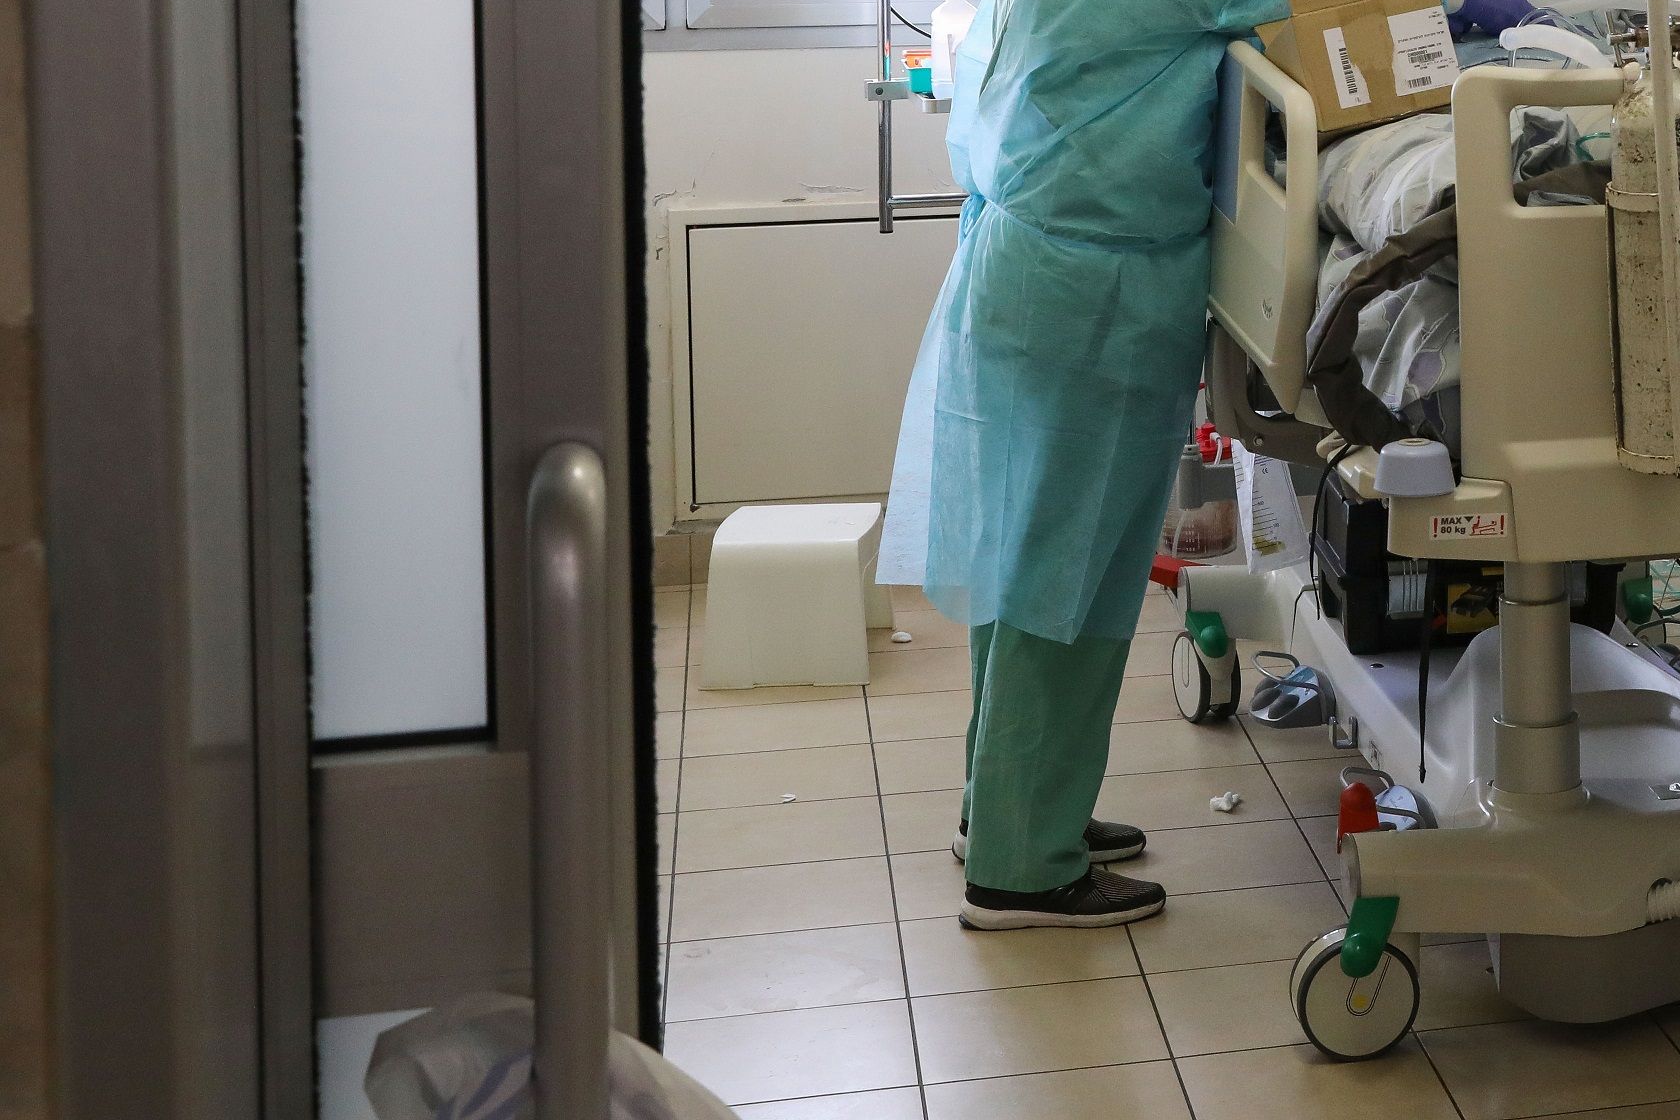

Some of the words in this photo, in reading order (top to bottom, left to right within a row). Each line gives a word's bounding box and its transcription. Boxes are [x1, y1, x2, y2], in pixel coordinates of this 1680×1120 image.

[1440, 516, 1462, 525] MAX
[1440, 526, 1452, 534] 80
[1454, 524, 1467, 535] kg
